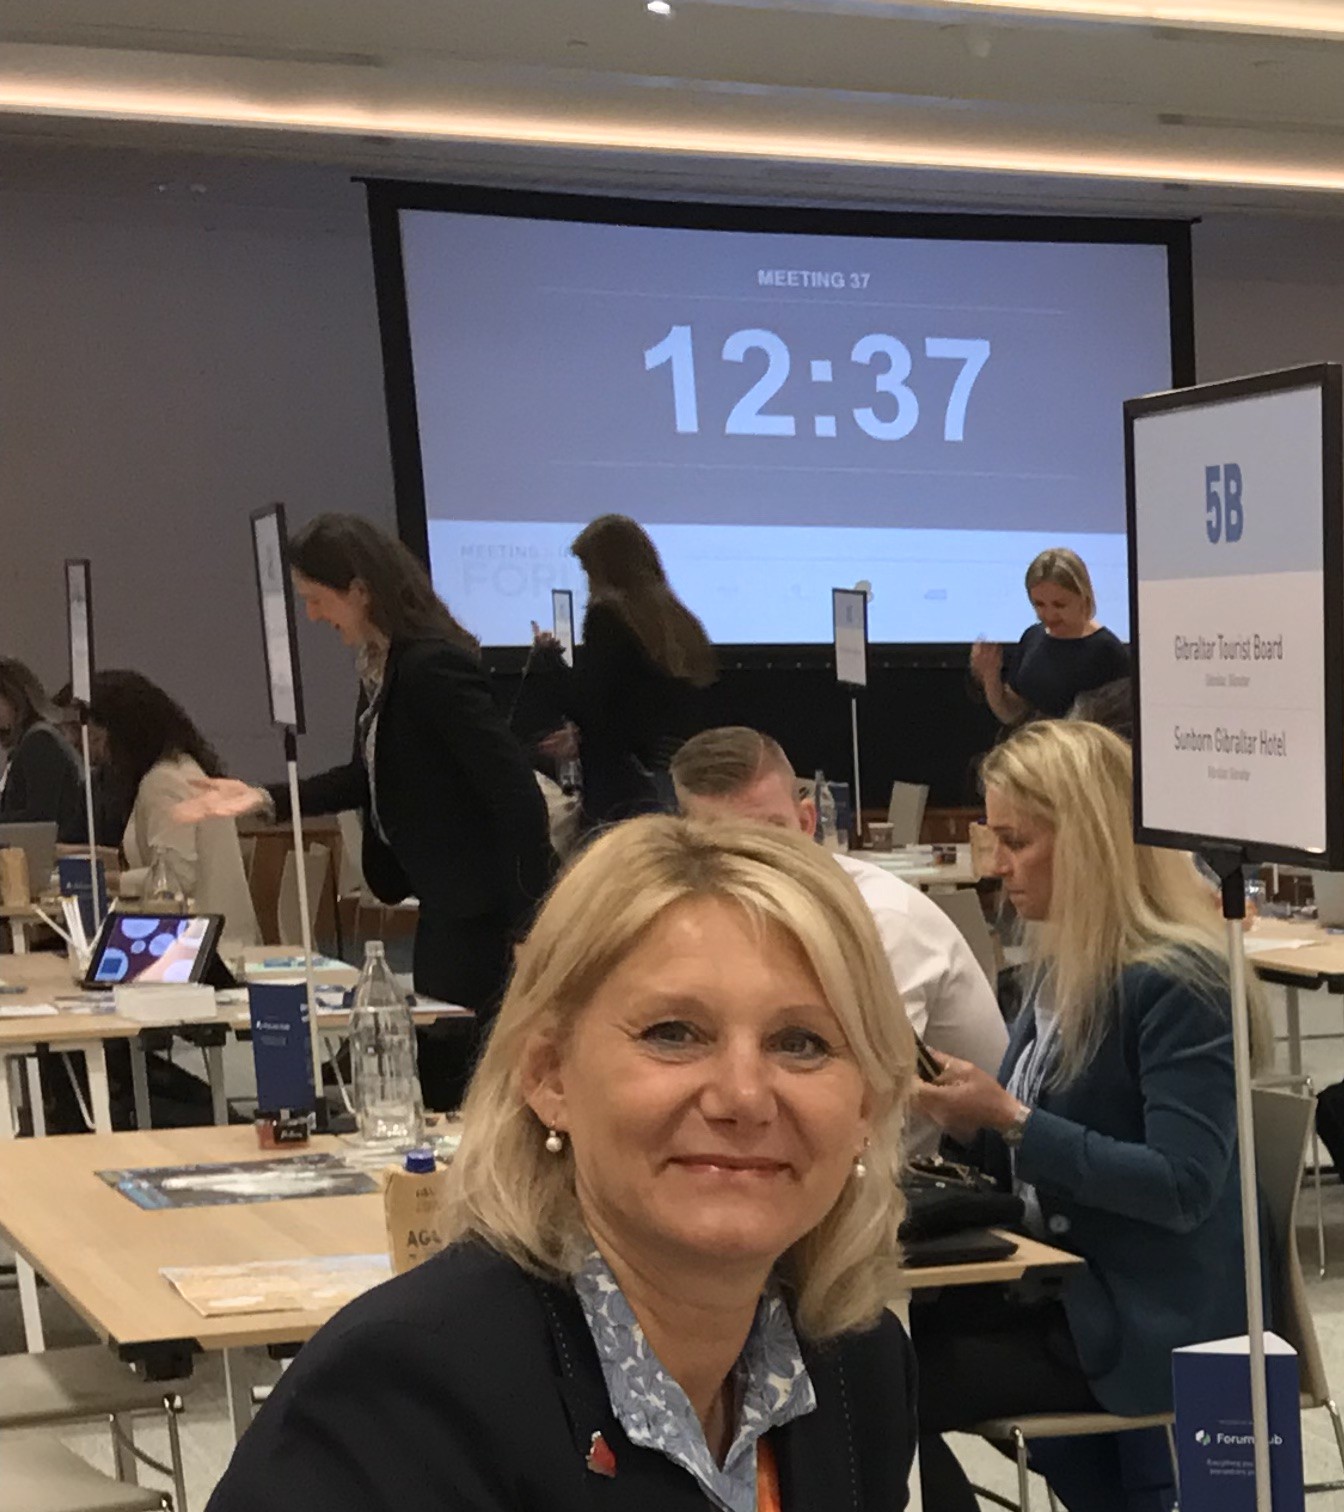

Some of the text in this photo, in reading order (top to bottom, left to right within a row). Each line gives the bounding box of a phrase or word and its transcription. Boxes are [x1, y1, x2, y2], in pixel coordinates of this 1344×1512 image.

[757, 267, 871, 291] MEETING 37
[643, 324, 992, 442] 12:37
[1204, 462, 1245, 545] 5B
[1174, 632, 1284, 662] Gibraltar Tourist Board
[1174, 725, 1288, 757] Sunborn Gibraltar Hotel
